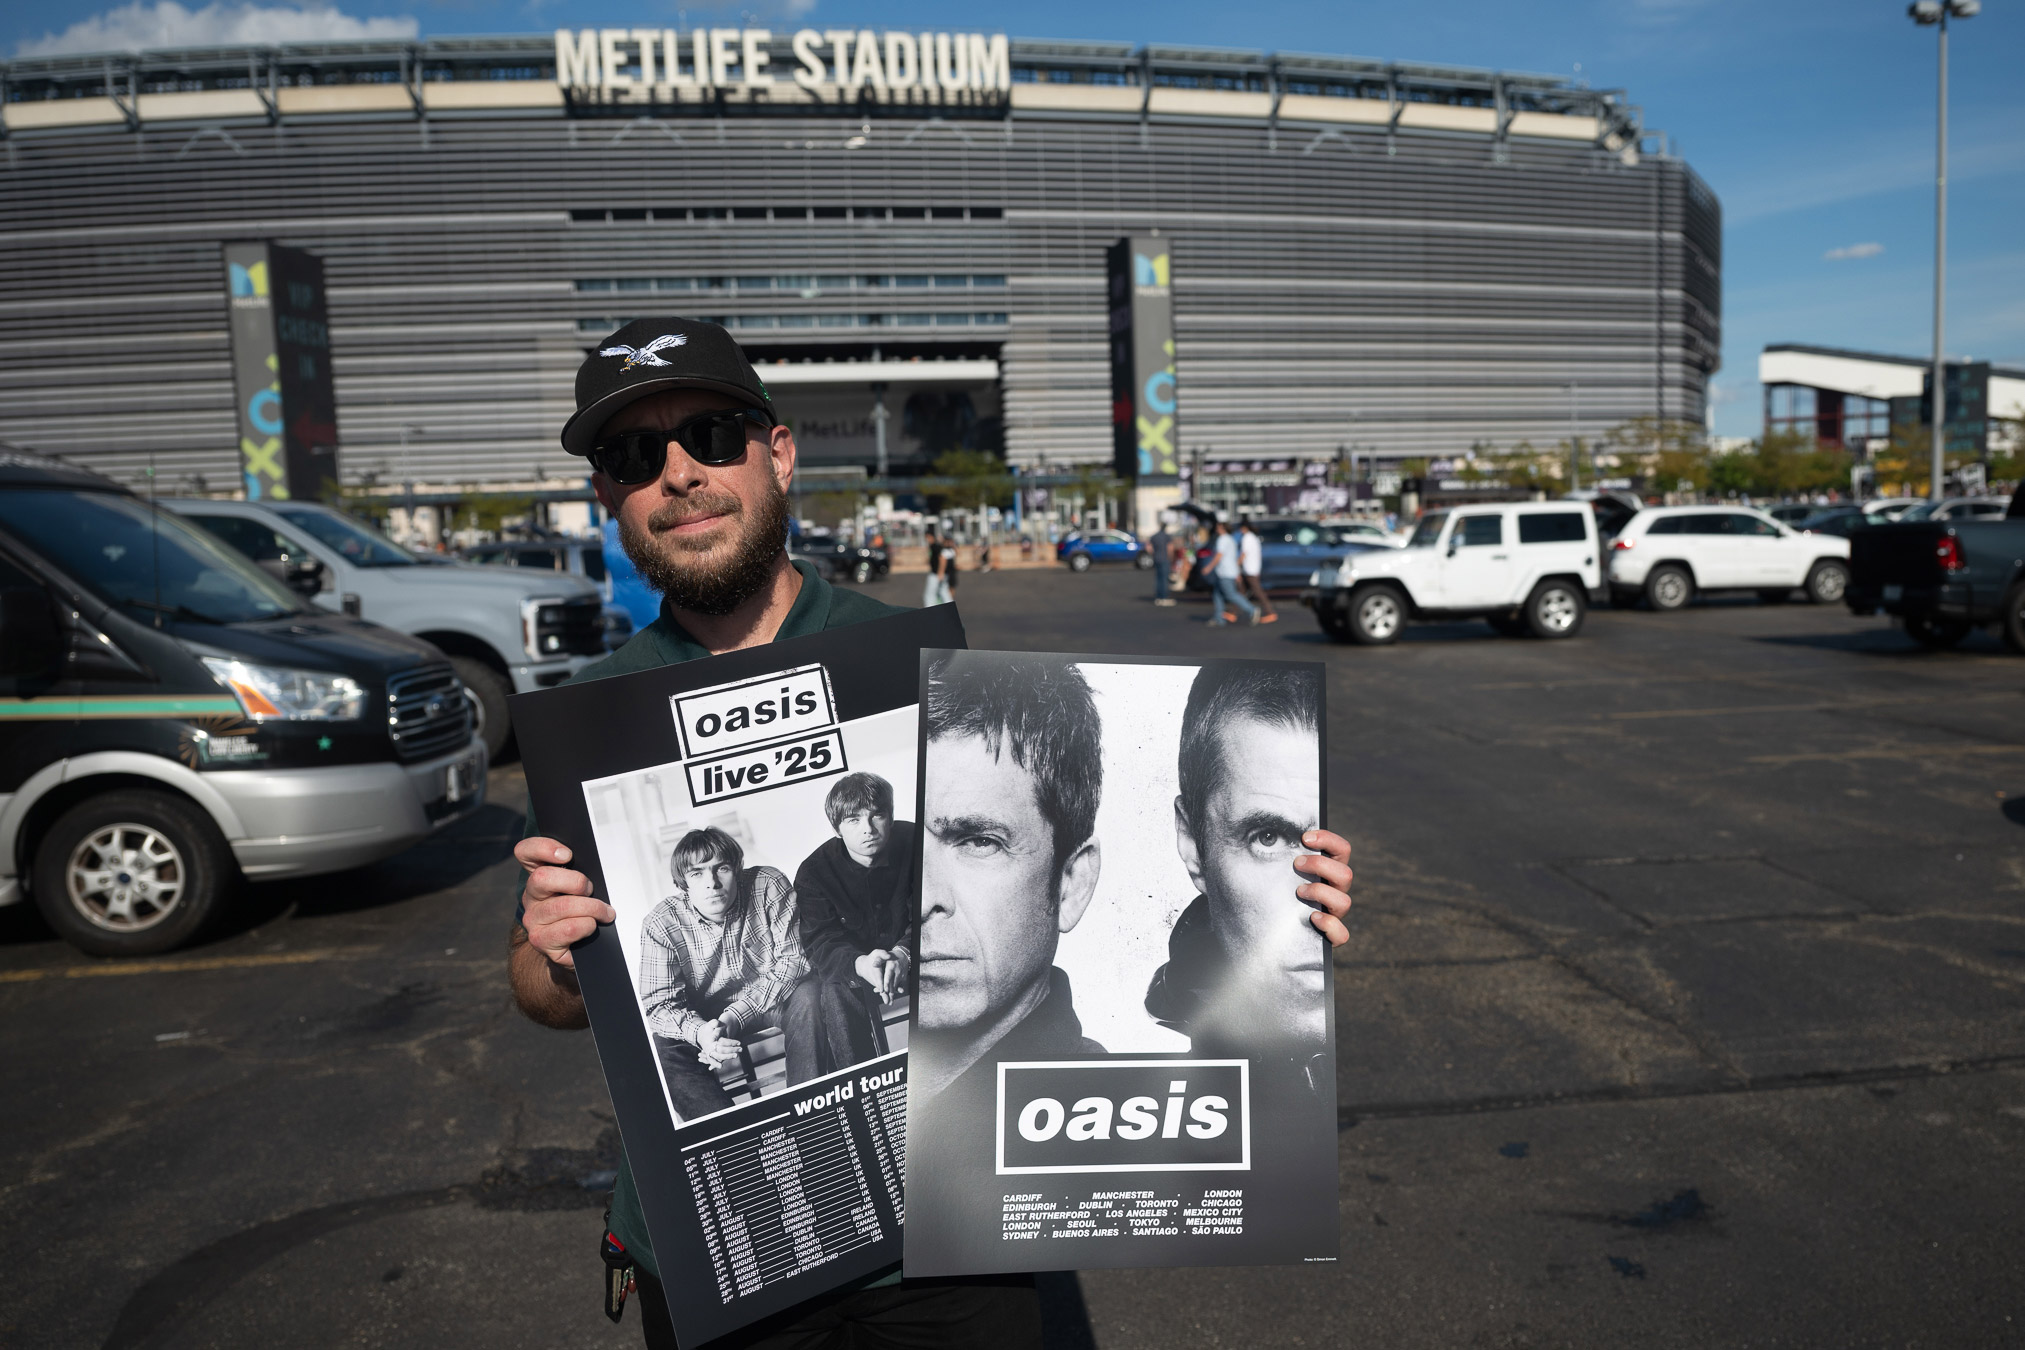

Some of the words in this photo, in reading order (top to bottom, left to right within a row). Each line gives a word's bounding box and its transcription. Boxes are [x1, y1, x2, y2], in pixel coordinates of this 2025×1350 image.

[554, 28, 776, 89] METLIFE
[792, 28, 1010, 91] STADIUM
[695, 686, 817, 738] oasis
[703, 762, 769, 796] live
[794, 1080, 854, 1116] world
[860, 1066, 904, 1093] tour
[878, 1091, 906, 1105] SEPTEMBE
[1017, 1080, 1229, 1142] oasis
[701, 1150, 715, 1160] JULY
[761, 1127, 784, 1139] CARDIFF
[703, 1157, 717, 1167] JULY
[763, 1133, 786, 1146] CARDIFF
[705, 1164, 719, 1174] JULY
[759, 1137, 796, 1155] MANCHESTER
[707, 1170, 721, 1180] JULY
[761, 1144, 798, 1161] MANCHESTER
[709, 1177, 723, 1187] JULY
[763, 1150, 800, 1168] MANCHESTER
[711, 1184, 725, 1194] JULY
[765, 1157, 802, 1174] MANCHESTER
[713, 1191, 727, 1201] JULY
[767, 1163, 804, 1181] MANCHESTER
[715, 1197, 729, 1207] JULY
[776, 1172, 798, 1185] LONDON
[717, 1204, 731, 1214] JULY
[778, 1179, 801, 1192] LONDON
[719, 1211, 733, 1221] JULY
[780, 1185, 802, 1198] LONDON
[1003, 1194, 1042, 1202] CARDIFF
[1092, 1191, 1154, 1200] MANCHESTER
[1205, 1190, 1242, 1198] LONDON
[1003, 1203, 1057, 1211] EDINBURGH
[721, 1214, 744, 1228] AUGUST
[782, 1192, 804, 1205] LONDON
[723, 1221, 746, 1235] AUGUST
[784, 1199, 806, 1212] LONDON
[725, 1228, 748, 1242] AUGUST
[781, 1203, 813, 1220] EDINBURGH
[1003, 1213, 1026, 1221] EAST
[1029, 1211, 1090, 1220] RUTHERFORD
[1106, 1210, 1124, 1218] LOS
[1003, 1222, 1041, 1230] LONDON
[1067, 1220, 1097, 1228] SEOUL
[727, 1235, 750, 1249] AUGUST
[783, 1210, 815, 1227] EDINBURGH
[729, 1242, 752, 1256] AUGUST
[785, 1217, 817, 1234] EDINBURGH
[731, 1248, 754, 1262] AUGUST
[793, 1226, 813, 1238] DUBLIN
[851, 1202, 874, 1215] IRELAND
[732, 1255, 756, 1269] AUGUST
[795, 1232, 815, 1245] DUBLIN
[853, 1209, 876, 1222] IRELAND
[734, 1262, 758, 1276] AUGUST
[794, 1238, 820, 1252] TORONTO
[856, 1215, 878, 1228] CANADA
[1003, 1231, 1039, 1240] SYDNEY
[1052, 1229, 1090, 1238] BUENOS
[1092, 1228, 1119, 1237] AIRES
[1132, 1228, 1178, 1236] SANTIAGO
[1192, 1225, 1210, 1235] SÃO
[736, 1269, 760, 1284] AUGUST
[796, 1244, 822, 1259] TORONTO
[858, 1222, 880, 1235] CANADA
[738, 1276, 762, 1291] AUGUST
[798, 1252, 824, 1266] CHICAGO
[871, 1228, 882, 1237] USA
[740, 1283, 764, 1298] AUGUST
[787, 1268, 801, 1278] EAST
[802, 1253, 839, 1272] RUTHERFORD
[872, 1234, 884, 1243] USA
